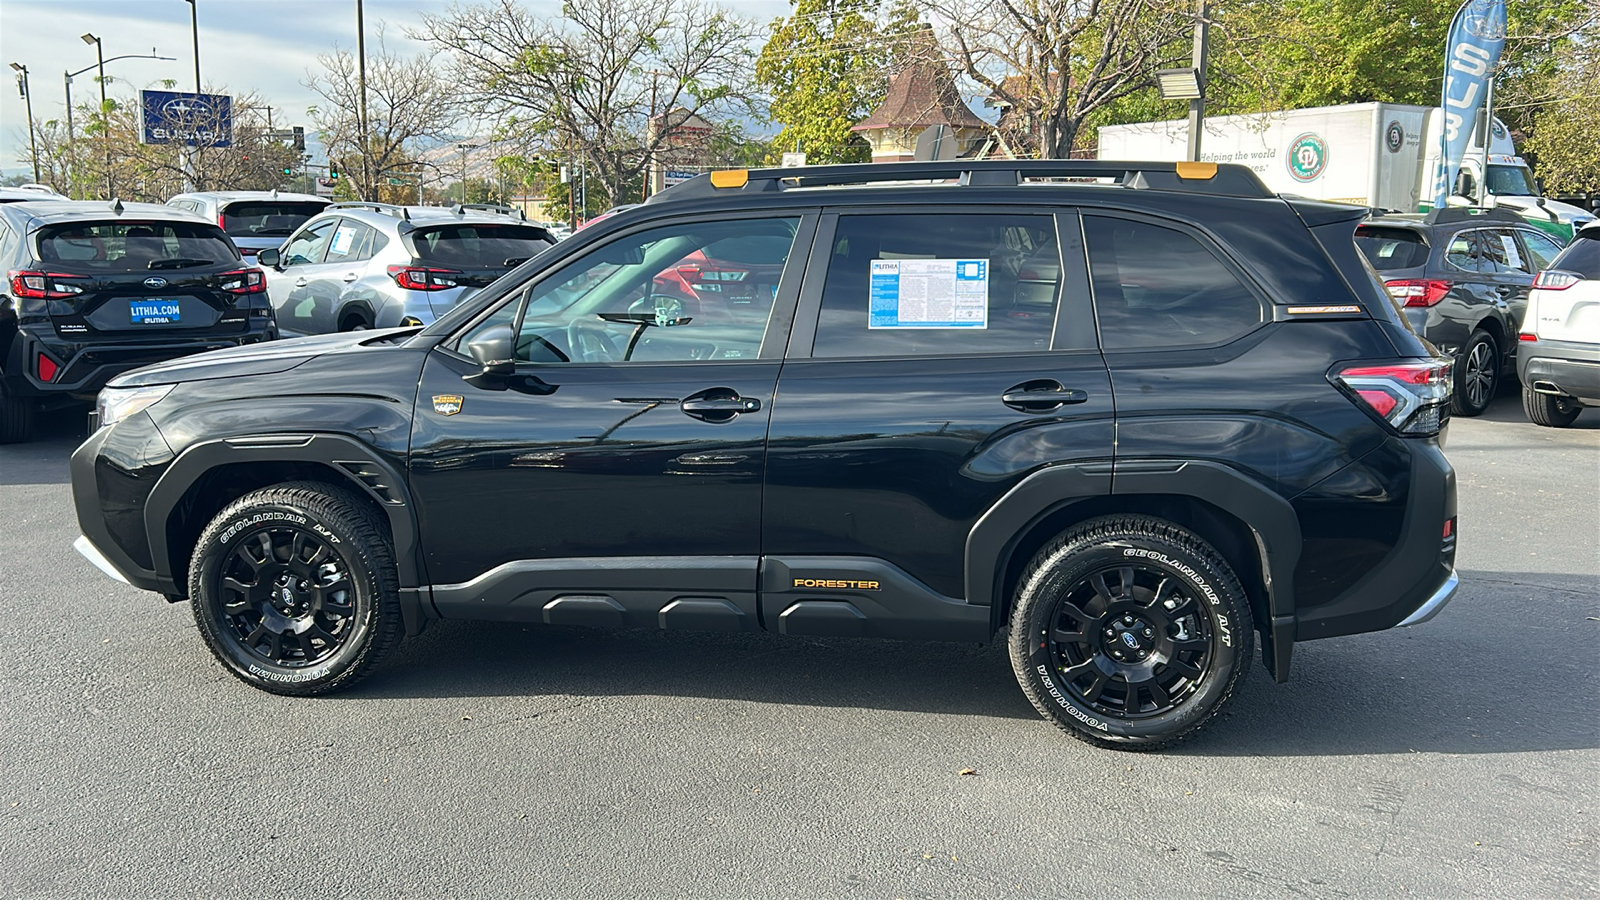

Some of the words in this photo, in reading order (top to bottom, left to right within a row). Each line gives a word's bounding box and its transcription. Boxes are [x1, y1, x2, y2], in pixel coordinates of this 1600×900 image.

[1200, 153, 1233, 163] Helping
[1235, 151, 1249, 160] the
[1250, 149, 1276, 159] world
[131, 305, 180, 316] LITHIA.COM
[220, 512, 307, 544] GEOLANDAR
[313, 523, 341, 544] A/T
[794, 578, 880, 589] FORESTER
[1123, 548, 1220, 606] GEOLANDAR
[1216, 613, 1232, 648] A/T
[248, 664, 331, 683] YOKOHAMA
[1036, 664, 1109, 732] YOKOHAMA
